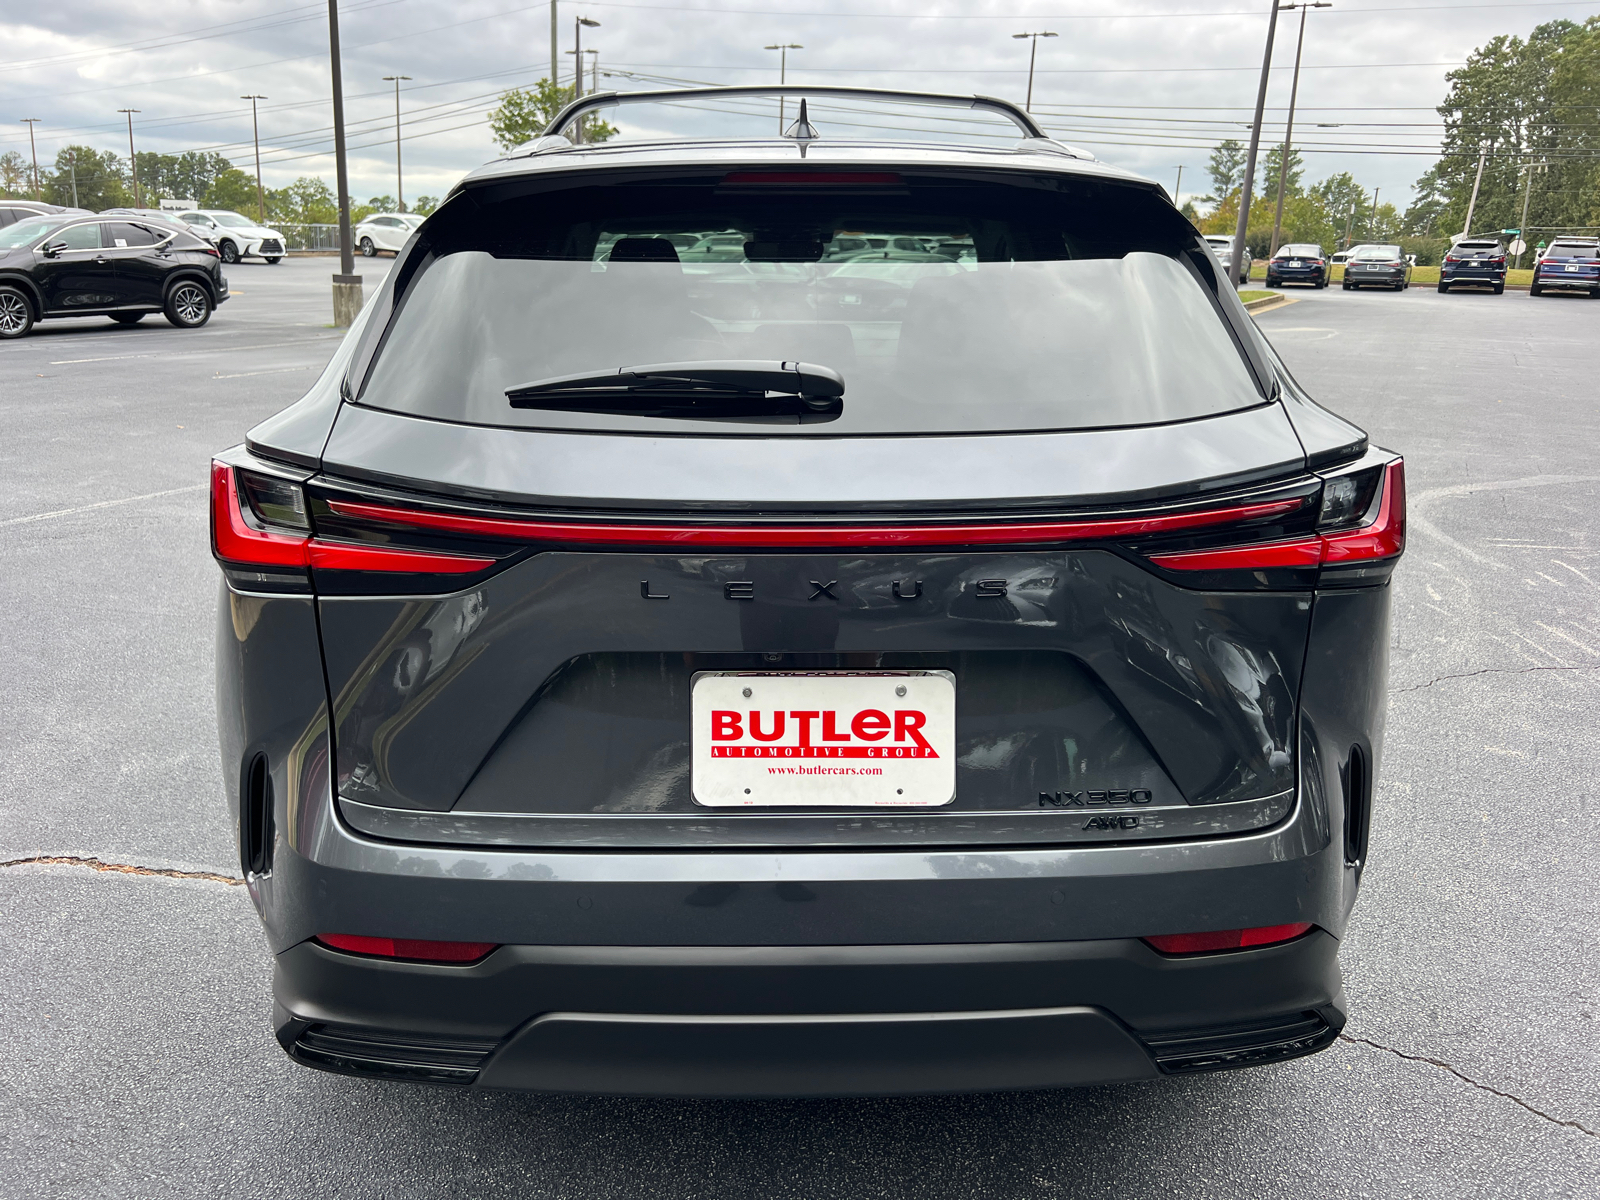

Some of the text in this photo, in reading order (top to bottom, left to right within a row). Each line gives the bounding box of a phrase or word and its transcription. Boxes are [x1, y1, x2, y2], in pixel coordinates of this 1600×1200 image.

[640, 578, 1008, 600] LEXUS
[712, 747, 932, 757] AUTOMOTIVE GROUP
[767, 765, 883, 775] www.butlercars.com
[1082, 815, 1140, 830] AWD
